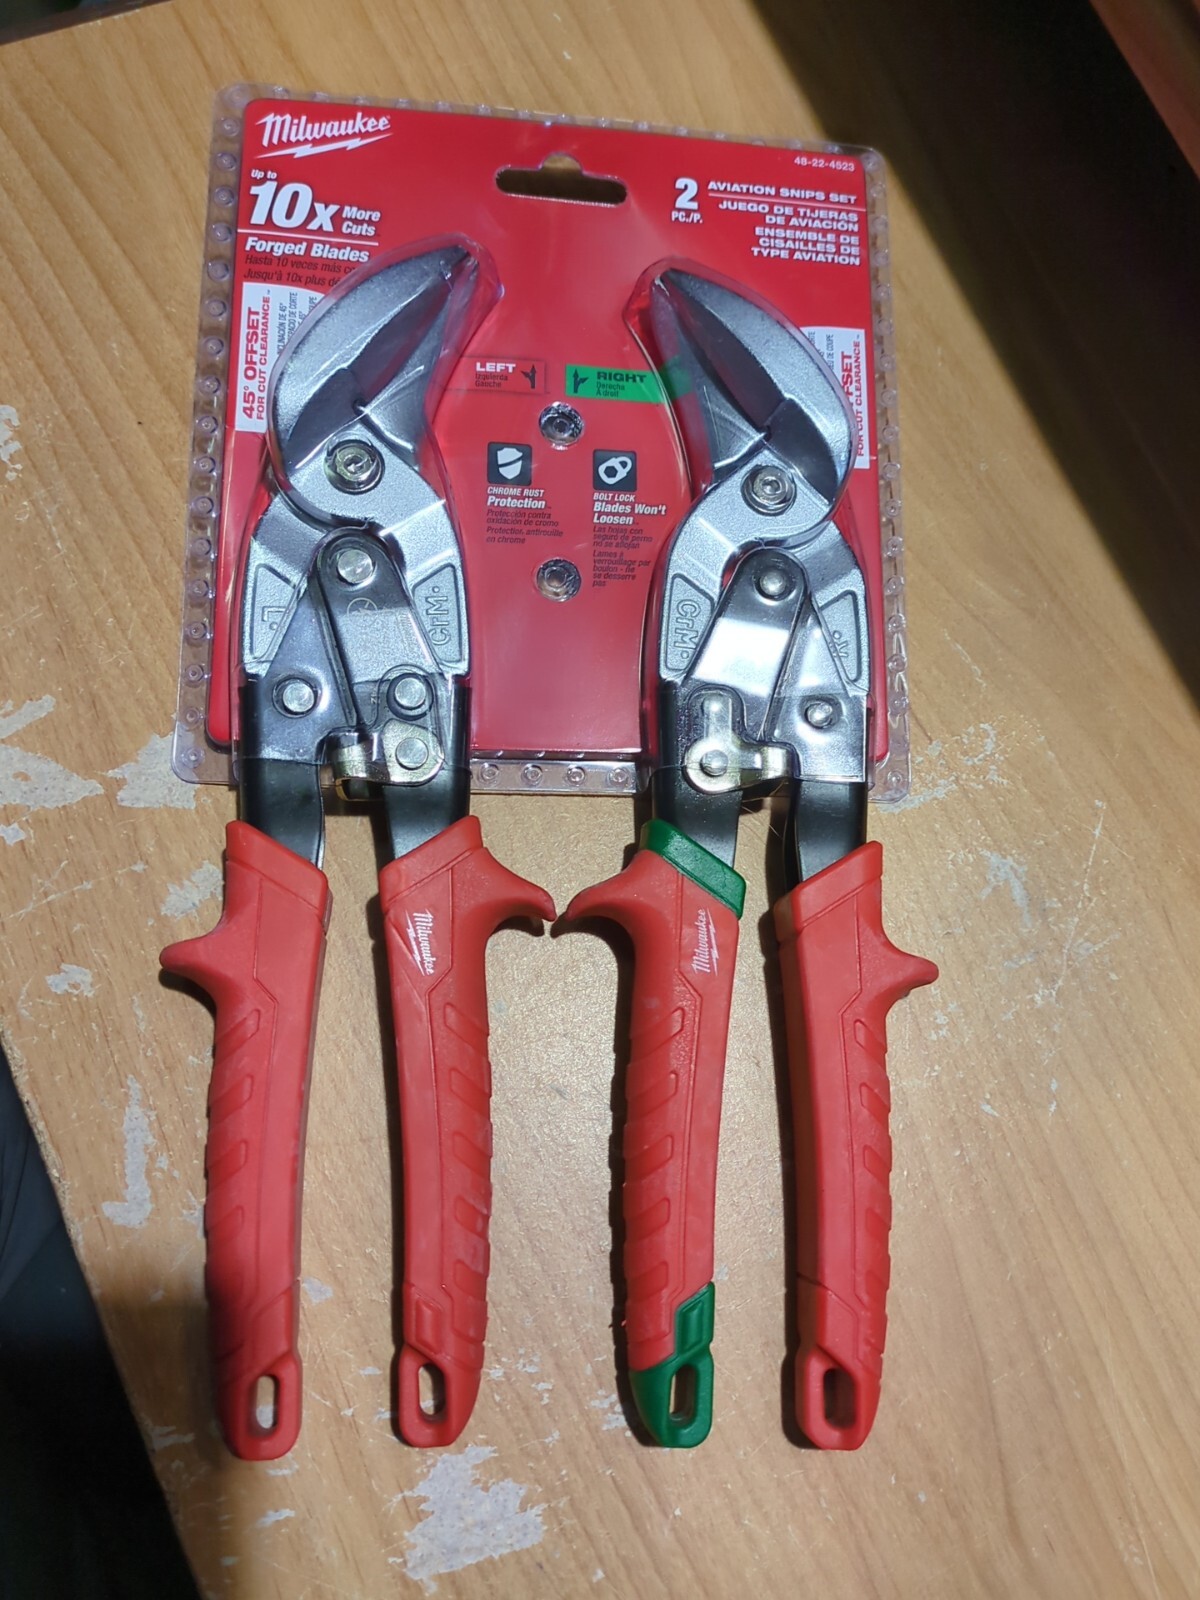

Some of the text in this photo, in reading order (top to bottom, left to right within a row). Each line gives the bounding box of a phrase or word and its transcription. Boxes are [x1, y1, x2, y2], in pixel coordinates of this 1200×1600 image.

[255, 112, 391, 147] Milwaukee
[794, 156, 855, 172] 48-22-4523
[251, 169, 277, 180] Up to
[674, 177, 699, 210] 2
[707, 181, 856, 204] AVIATION SNIPS SET
[249, 181, 340, 231] 10x
[342, 206, 380, 222] More
[719, 200, 858, 222] JUEGO DE TIJERAS
[671, 211, 703, 223] PC./P.
[765, 215, 859, 232] DE AVIACIÓN
[342, 220, 376, 236] Cuts
[755, 227, 859, 245] ENSEMBLE DE
[245, 236, 370, 262] Forged Blades
[759, 238, 860, 255] CISAILLES DE
[245, 254, 272, 266] Hasta
[276, 257, 288, 267] 10
[291, 260, 318, 269] veces
[321, 262, 341, 273] más
[751, 247, 860, 266] TYPE AVIATION
[244, 268, 282, 281] Jusqu'à
[286, 272, 303, 282] 10x
[305, 276, 326, 287] plus
[242, 307, 260, 419] 45° OFFSET
[256, 296, 270, 420] FOR CUT CLEARANCE
[476, 362, 516, 373] LEFT
[854, 341, 862, 406] CLEARANCE
[597, 371, 647, 383] RIGHT
[487, 486, 545, 497] CHROME RUST
[593, 492, 635, 502] BOLT LOCK
[487, 495, 546, 509] Protection
[593, 502, 667, 515] Blades Won't
[523, 518, 534, 526] de
[527, 511, 552, 519] contra
[593, 513, 633, 525] Loosen
[413, 908, 435, 975] Milwaukee
[691, 908, 711, 973] Milwaukee
